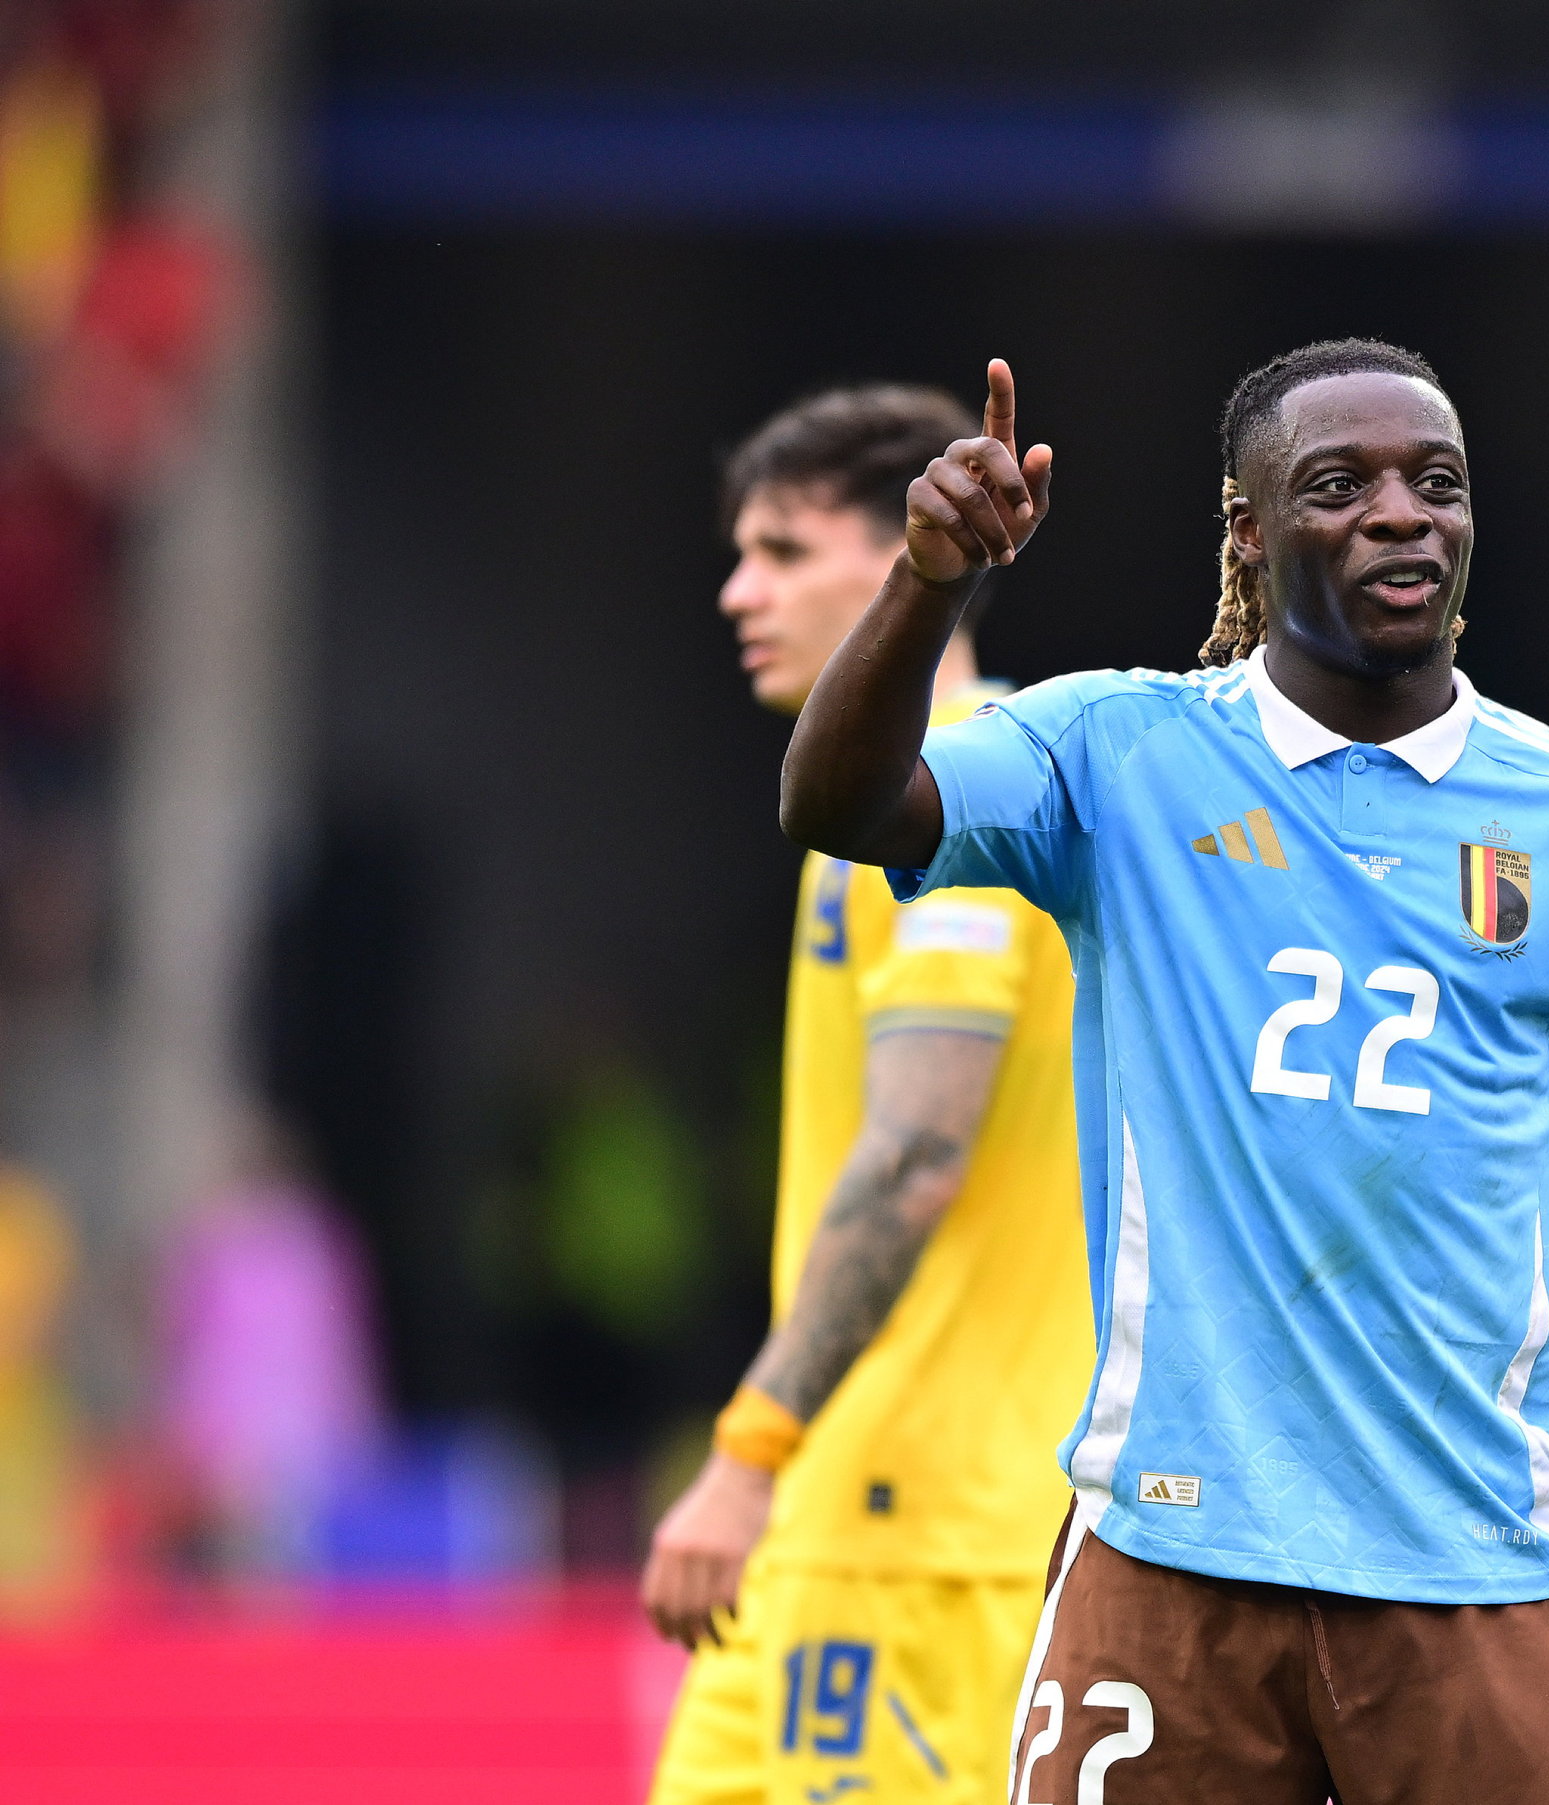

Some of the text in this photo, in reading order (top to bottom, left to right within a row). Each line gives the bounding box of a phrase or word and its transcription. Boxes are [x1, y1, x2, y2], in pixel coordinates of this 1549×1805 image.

[1368, 855, 1402, 867] BELGIUM
[1495, 850, 1521, 863] ROYAL
[1495, 859, 1530, 872] BELGIAN
[1370, 864, 1391, 874] 2024
[1250, 946, 1440, 1116] 22
[1259, 1456, 1299, 1476] 1895
[1471, 1523, 1540, 1546] HEAT.RDY
[780, 1639, 875, 1758] 19
[1016, 1680, 1155, 1805] 22
